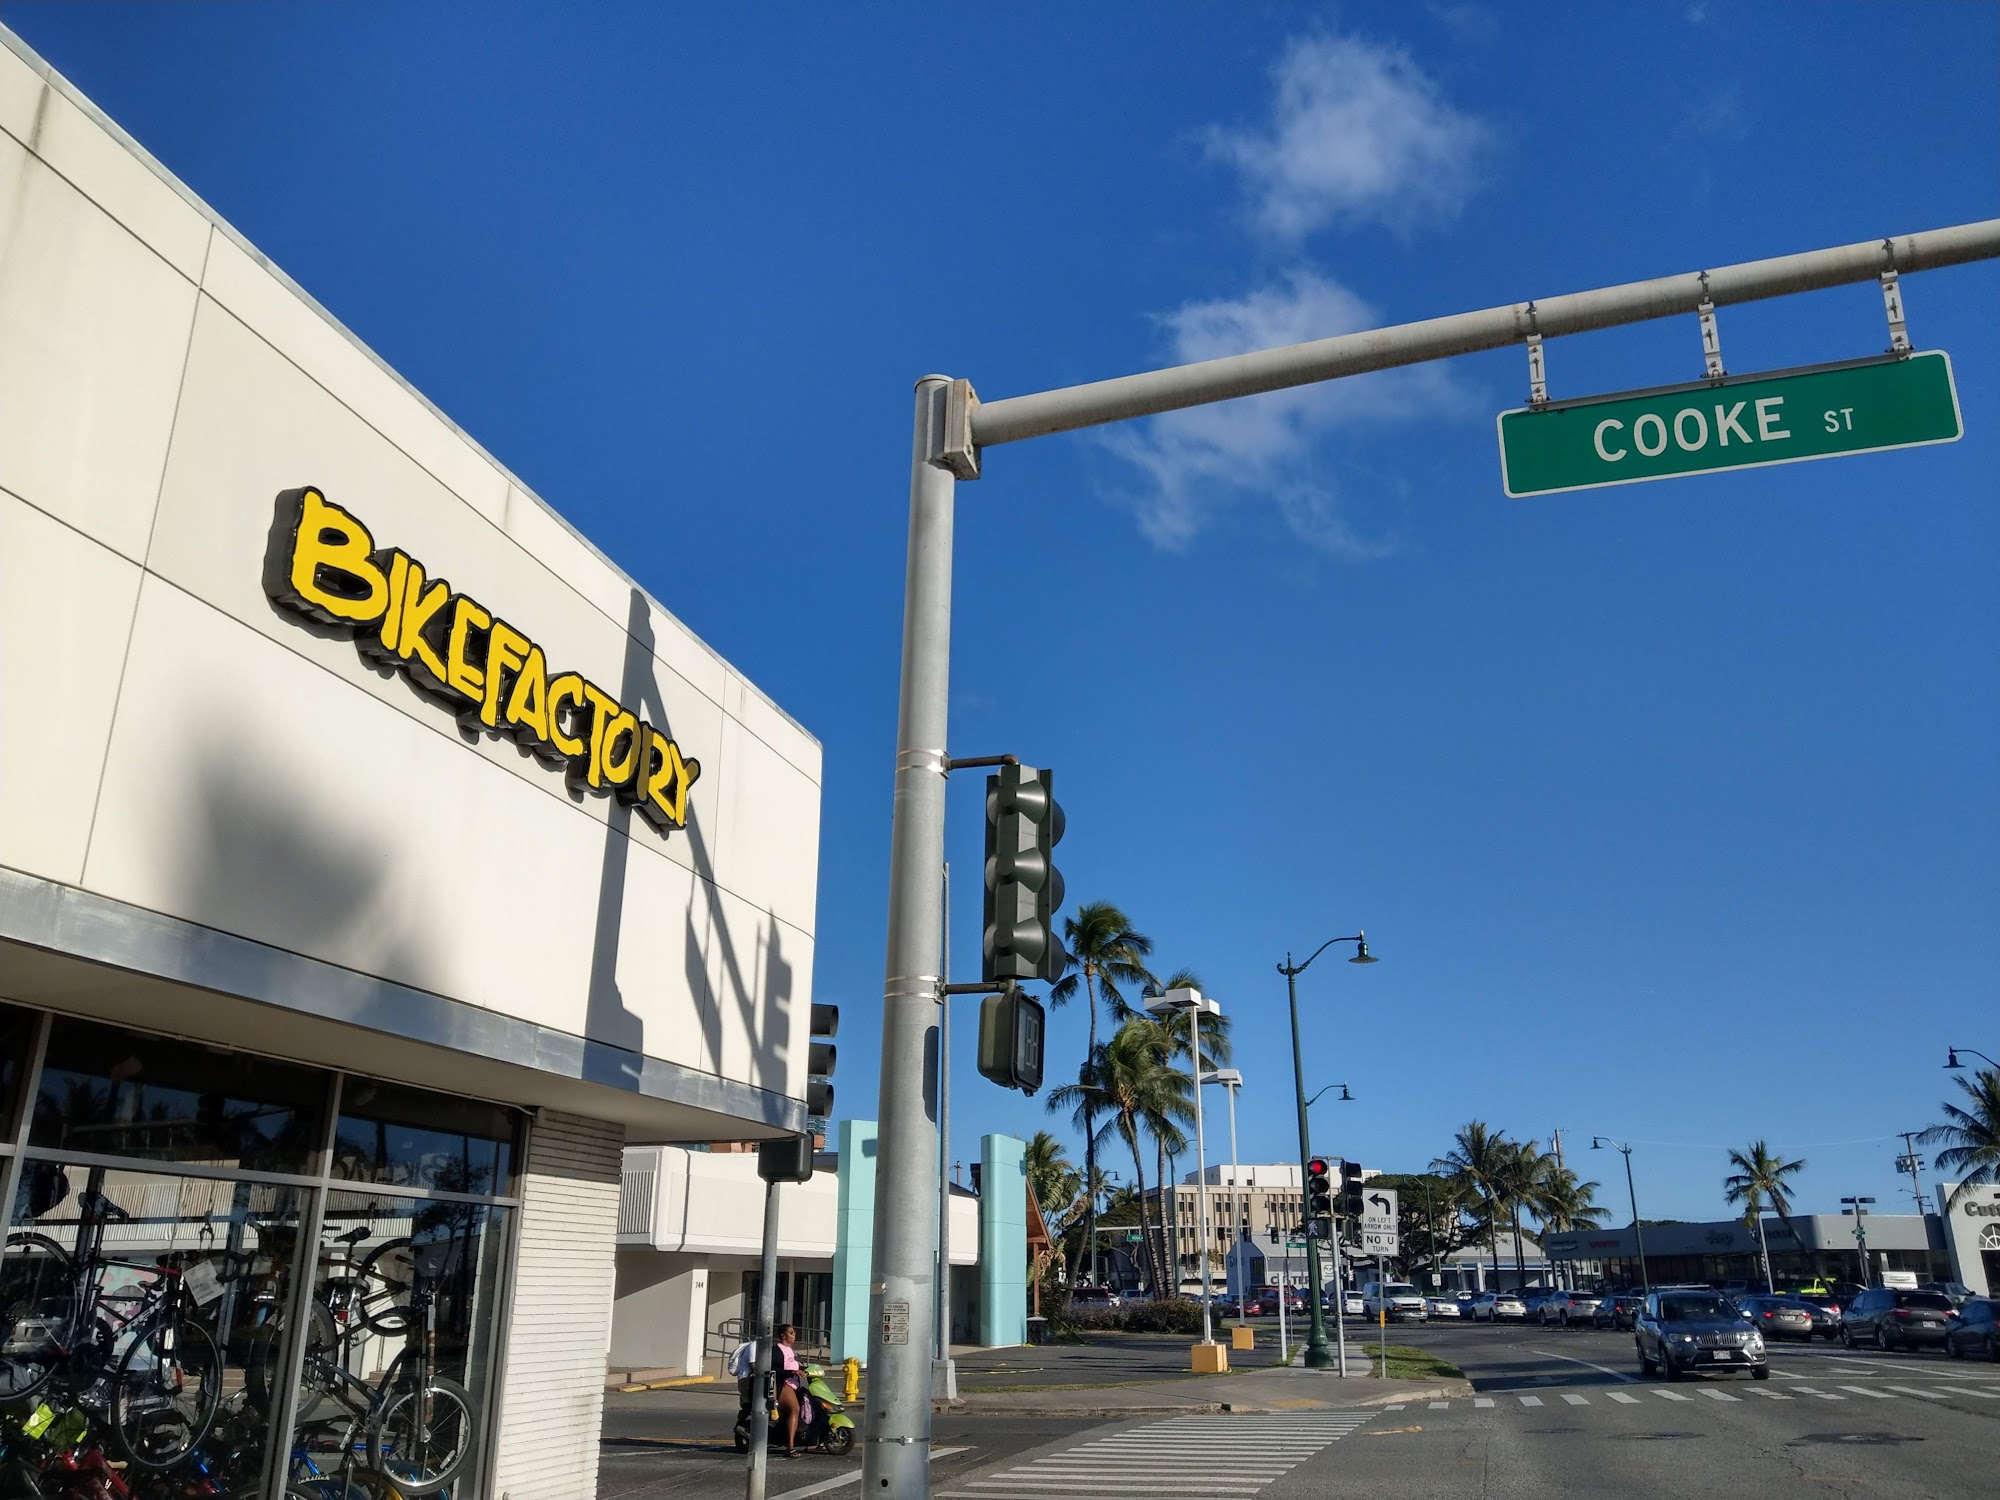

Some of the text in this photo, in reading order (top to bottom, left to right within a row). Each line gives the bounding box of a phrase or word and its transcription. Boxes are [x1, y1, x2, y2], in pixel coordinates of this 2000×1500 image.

[1593, 396, 1854, 462] COOKE ST
[1366, 1235, 1394, 1245] NO U
[1372, 1245, 1390, 1253] TURN
[1270, 1275, 1309, 1285] CTE
